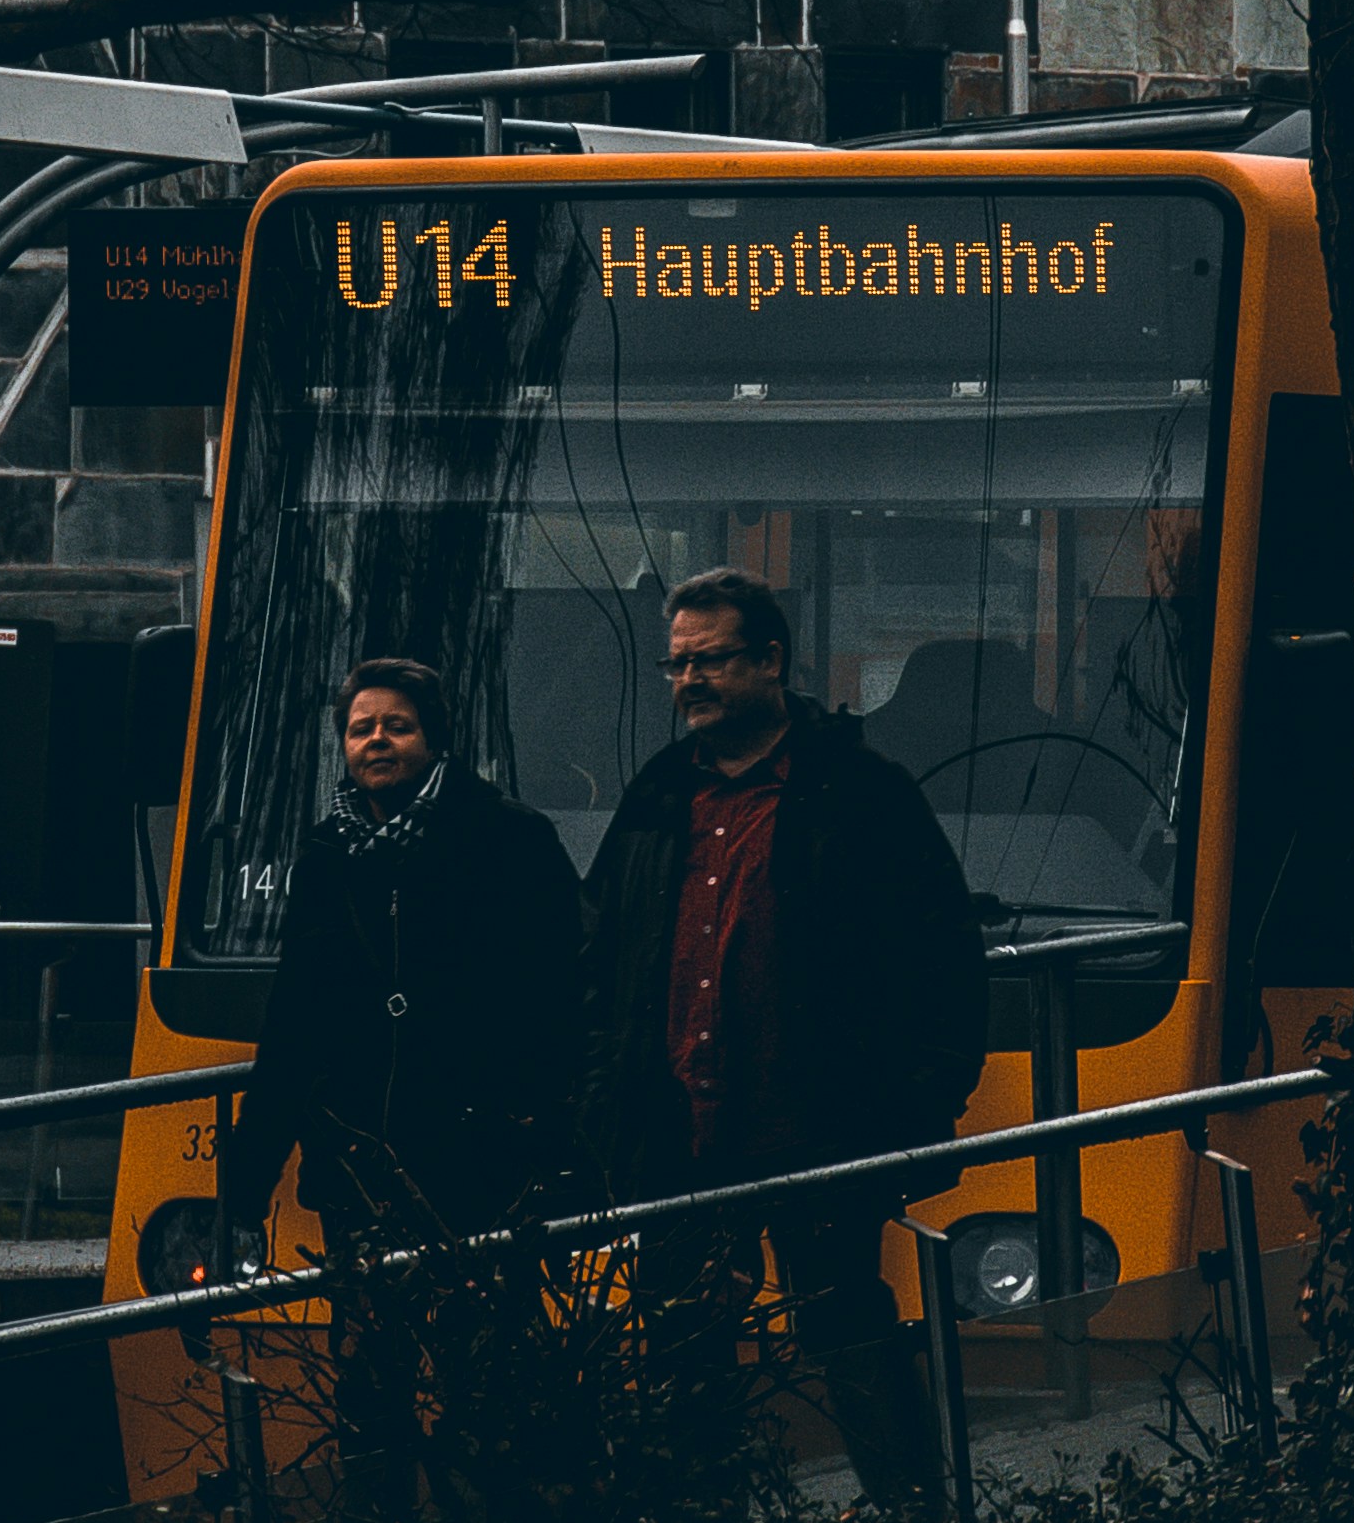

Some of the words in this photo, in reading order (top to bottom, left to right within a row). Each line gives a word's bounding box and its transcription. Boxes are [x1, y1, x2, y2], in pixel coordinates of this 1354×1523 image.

[105, 244, 148, 268] U14
[335, 218, 517, 310] U14
[600, 221, 1115, 312] Hauptbahnhof
[105, 278, 151, 301] U29
